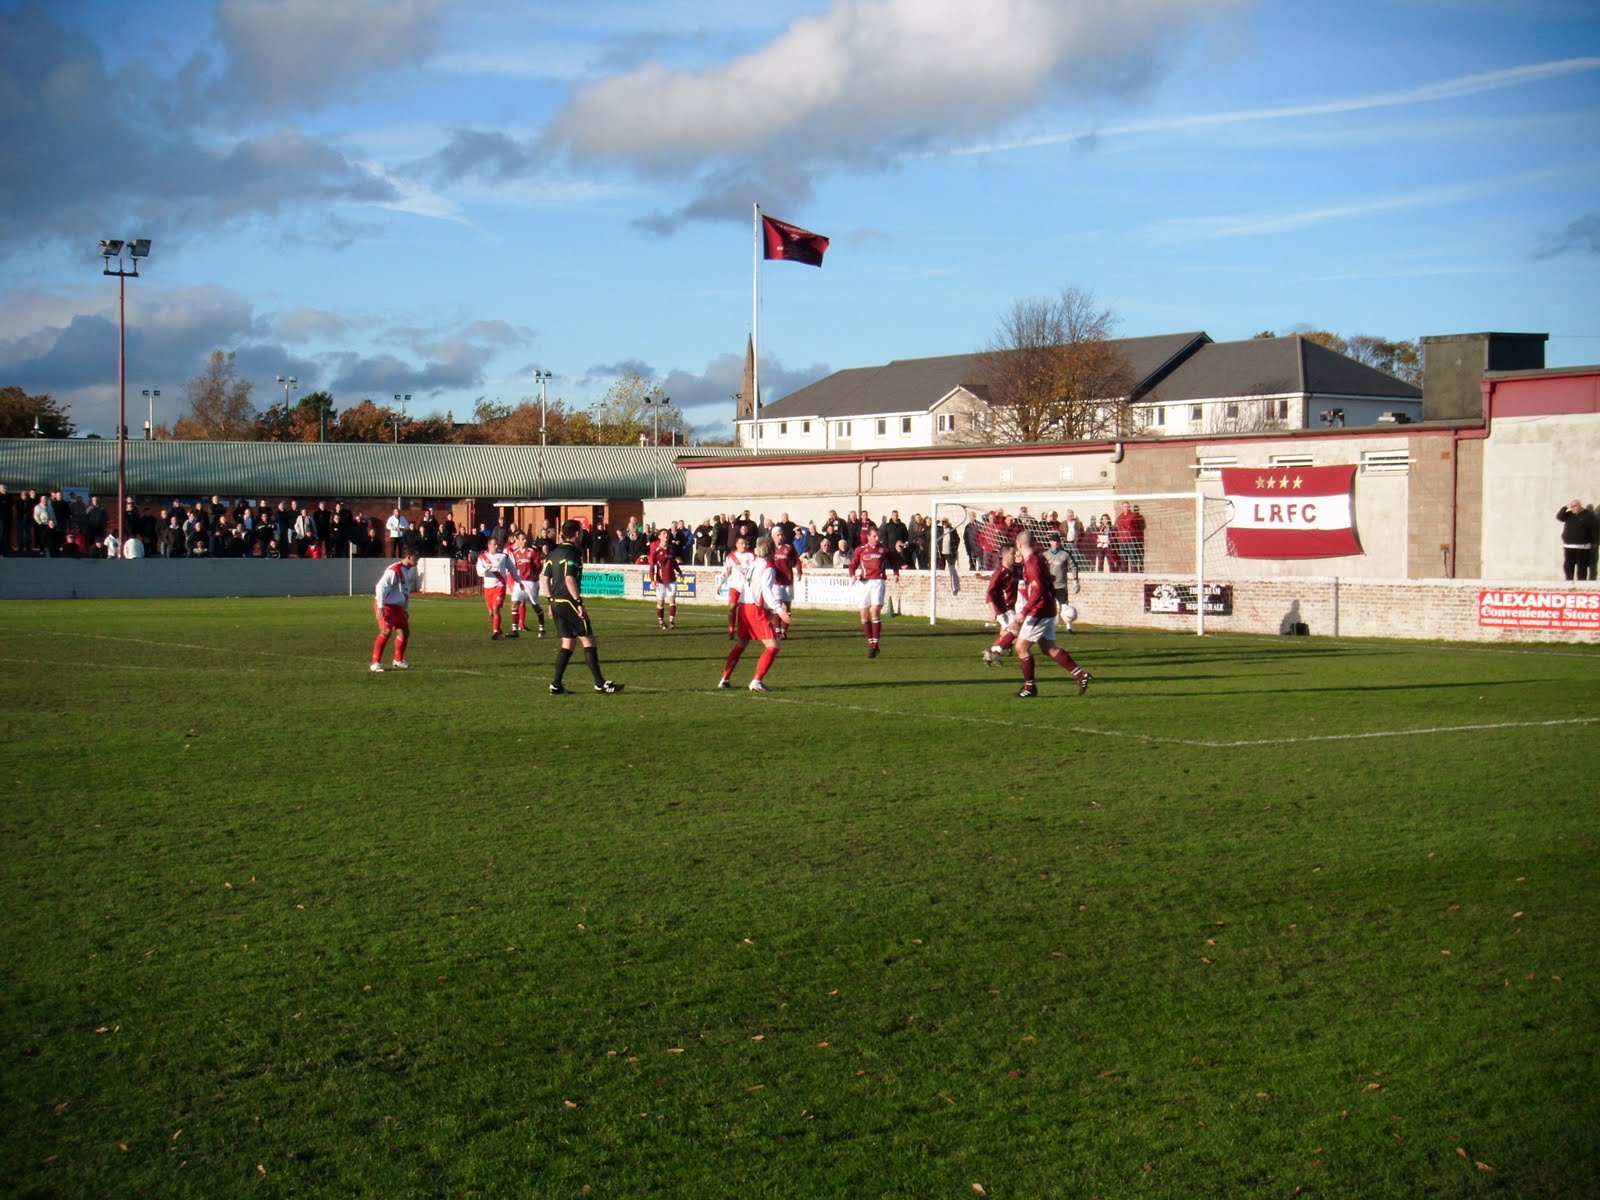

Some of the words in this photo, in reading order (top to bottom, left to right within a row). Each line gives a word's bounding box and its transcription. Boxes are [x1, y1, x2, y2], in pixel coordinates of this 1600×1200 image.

[1254, 504, 1317, 523] LRFC
[581, 574, 603, 582] enny's
[1481, 593, 1600, 609] ALEXANDERS
[1481, 606, 1560, 618] Convenience
[1562, 608, 1599, 620] Store
